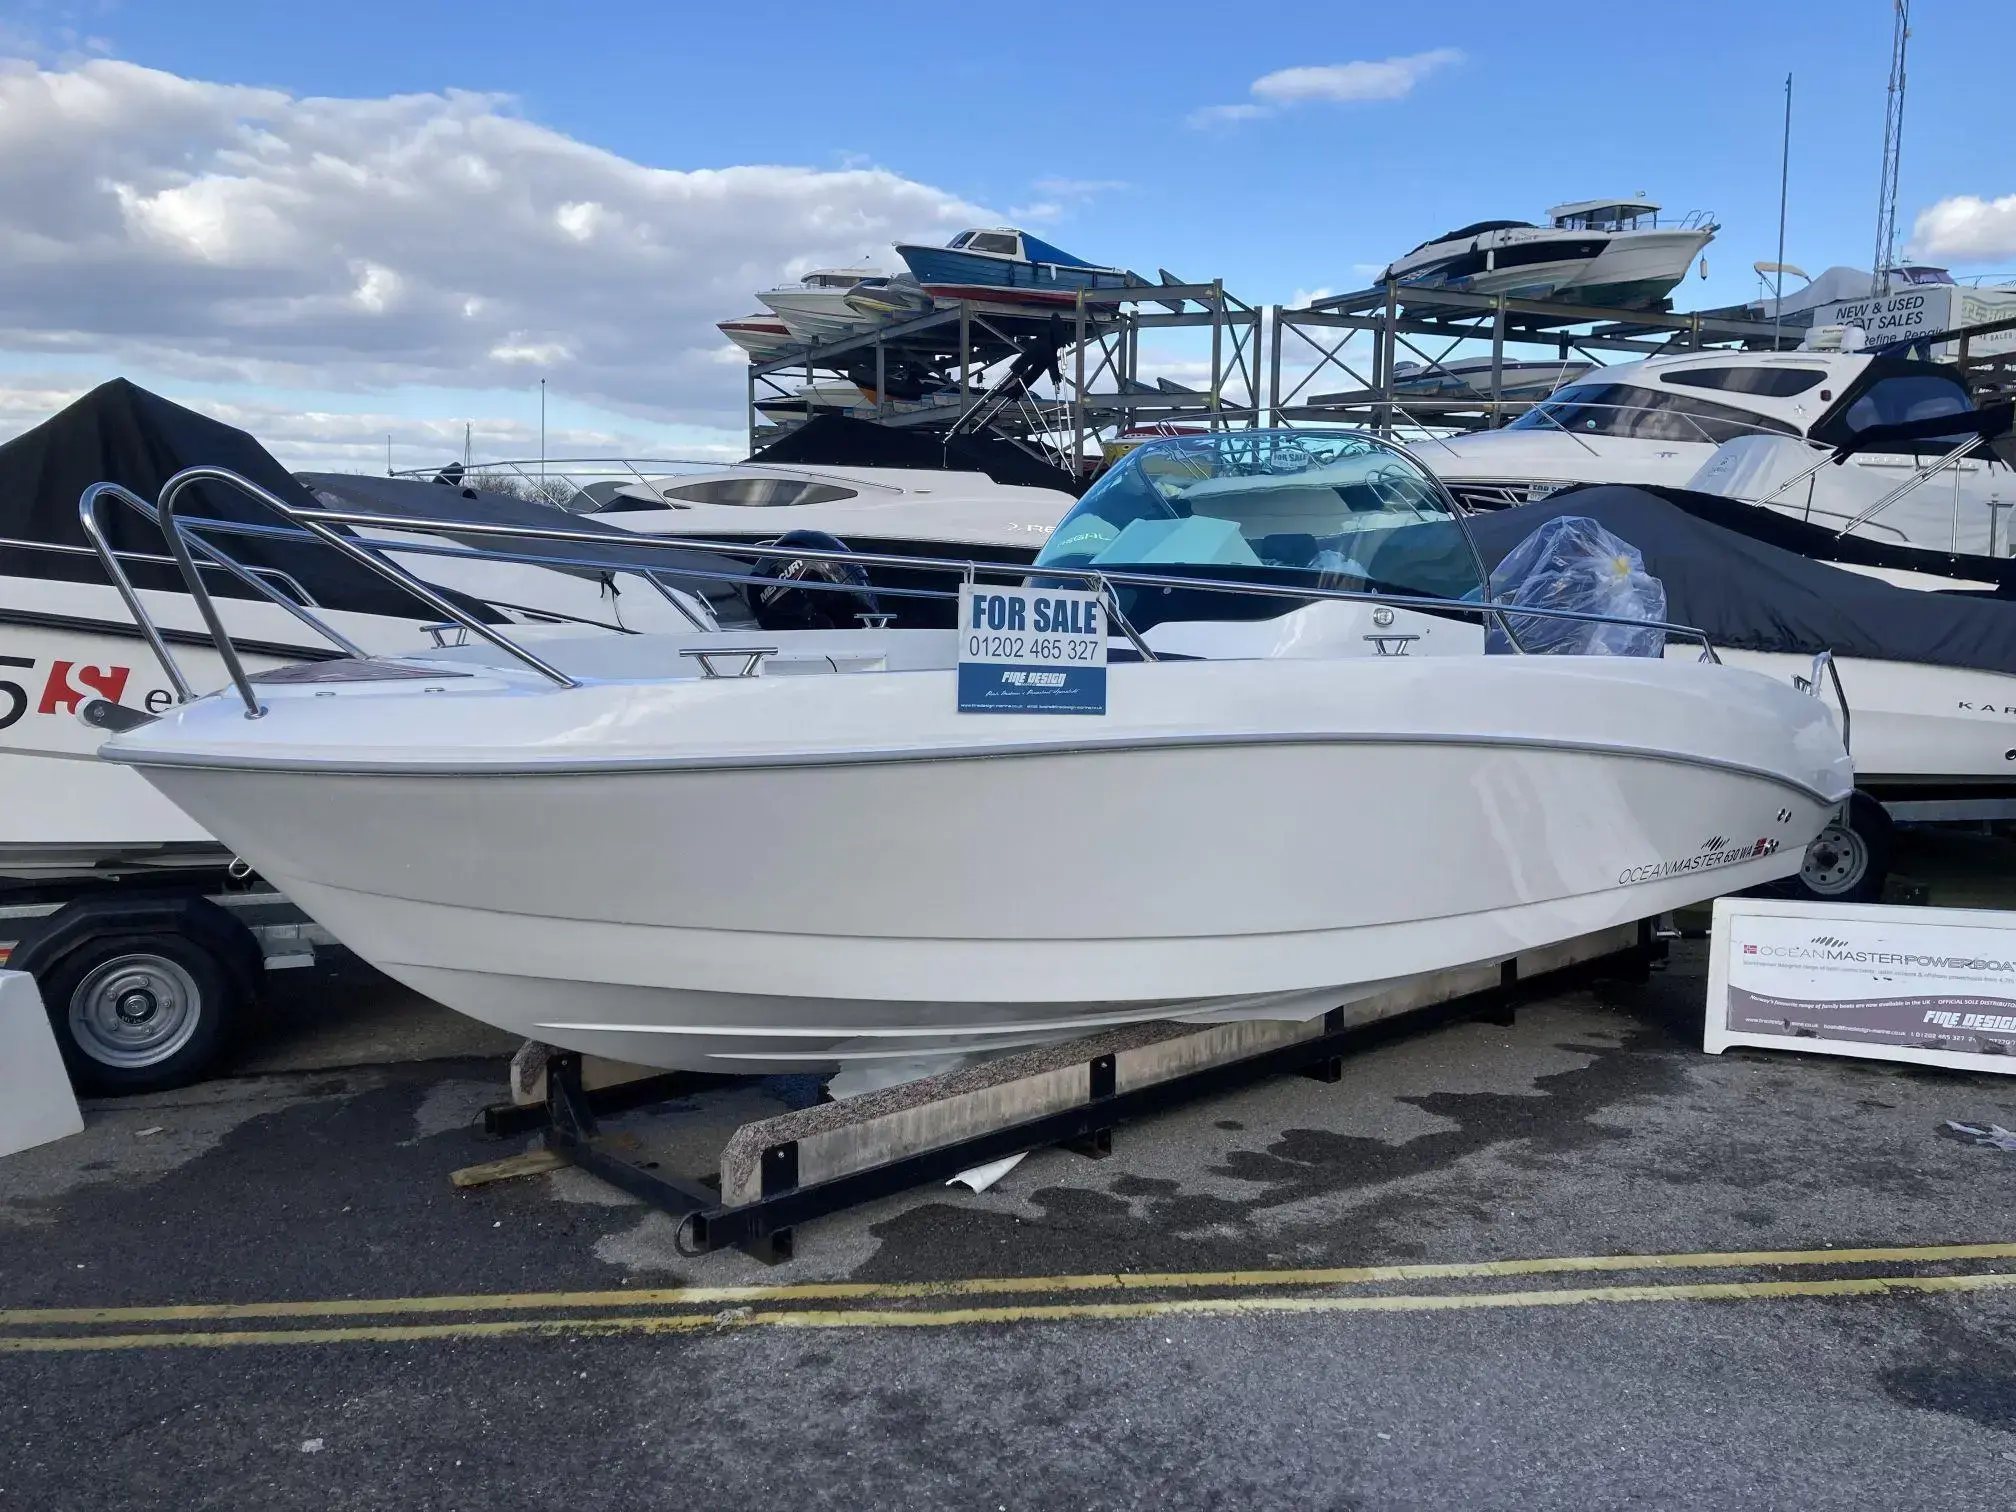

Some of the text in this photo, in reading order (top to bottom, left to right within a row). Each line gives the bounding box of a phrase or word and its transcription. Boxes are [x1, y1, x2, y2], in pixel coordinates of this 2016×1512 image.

[1836, 296, 1924, 319] NEW & USED
[1878, 311, 1923, 329] SALES
[760, 559, 803, 603] MECURY
[972, 594, 1098, 634] FOR SALE
[969, 635, 1099, 660] 01202 465 327
[1001, 671, 1067, 688] FINE DESIGN
[1618, 852, 1724, 885] OCEANMASTER
[1723, 848, 1739, 863] 630
[1922, 1010, 1961, 1028] FINE
